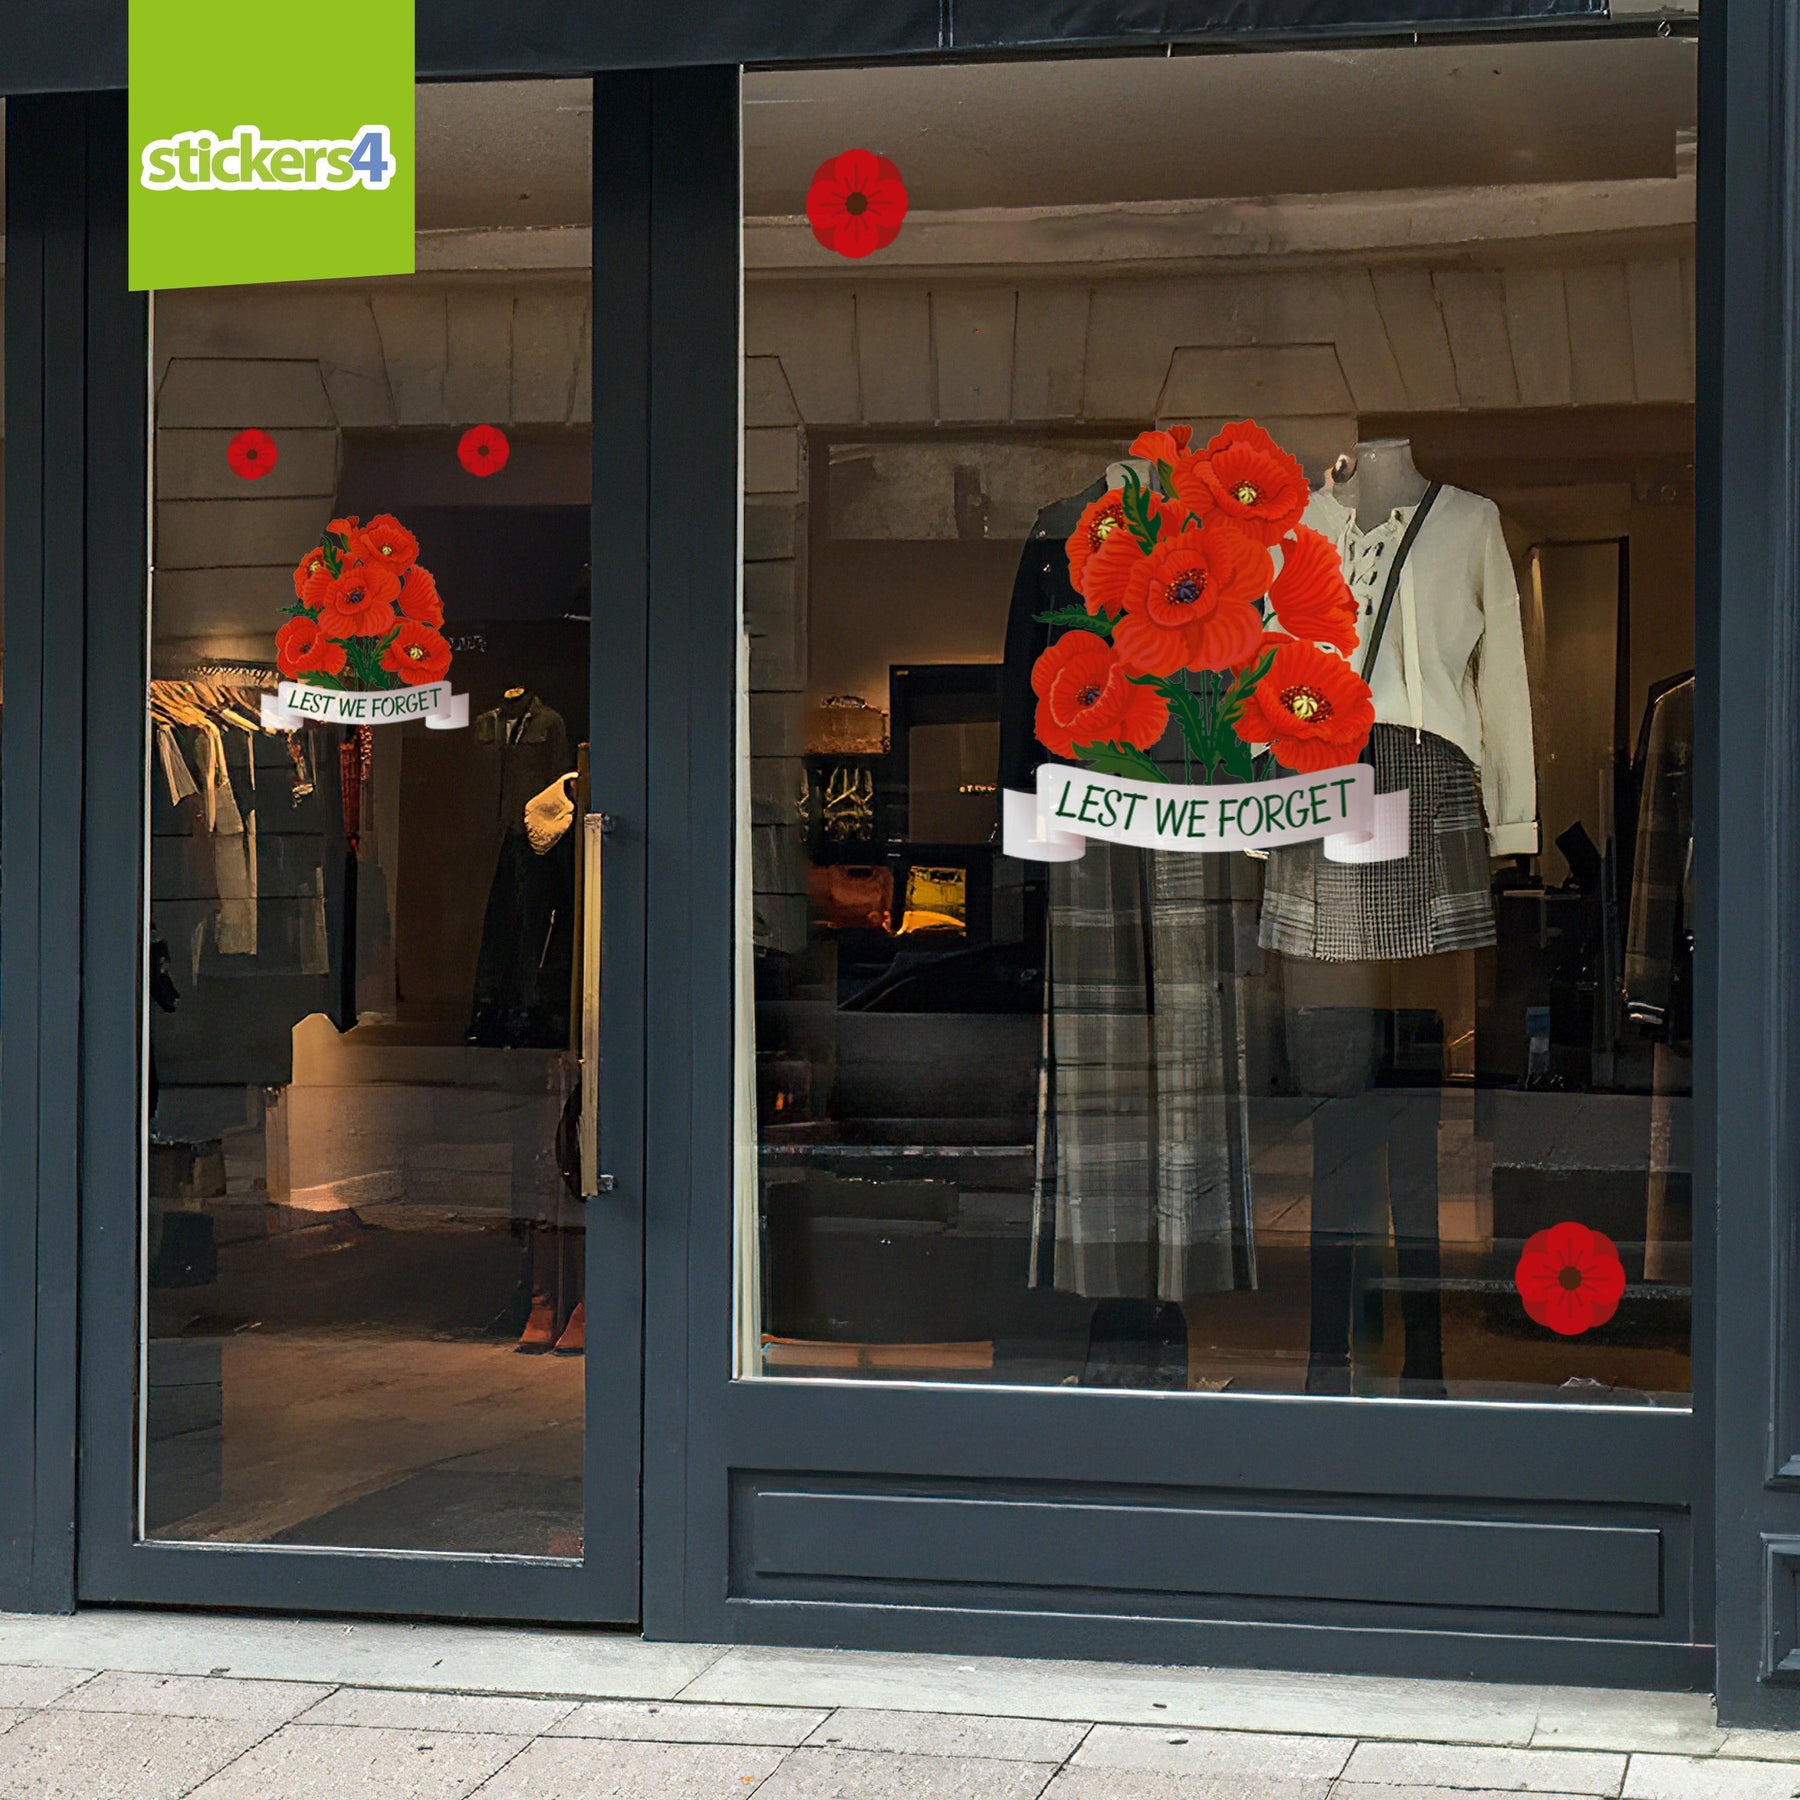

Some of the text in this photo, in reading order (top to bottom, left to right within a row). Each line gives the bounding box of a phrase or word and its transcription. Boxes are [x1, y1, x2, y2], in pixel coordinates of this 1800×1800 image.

[287, 687, 442, 719] LEST WE FORGET
[1055, 777, 1356, 838] LEST WE FORGET
